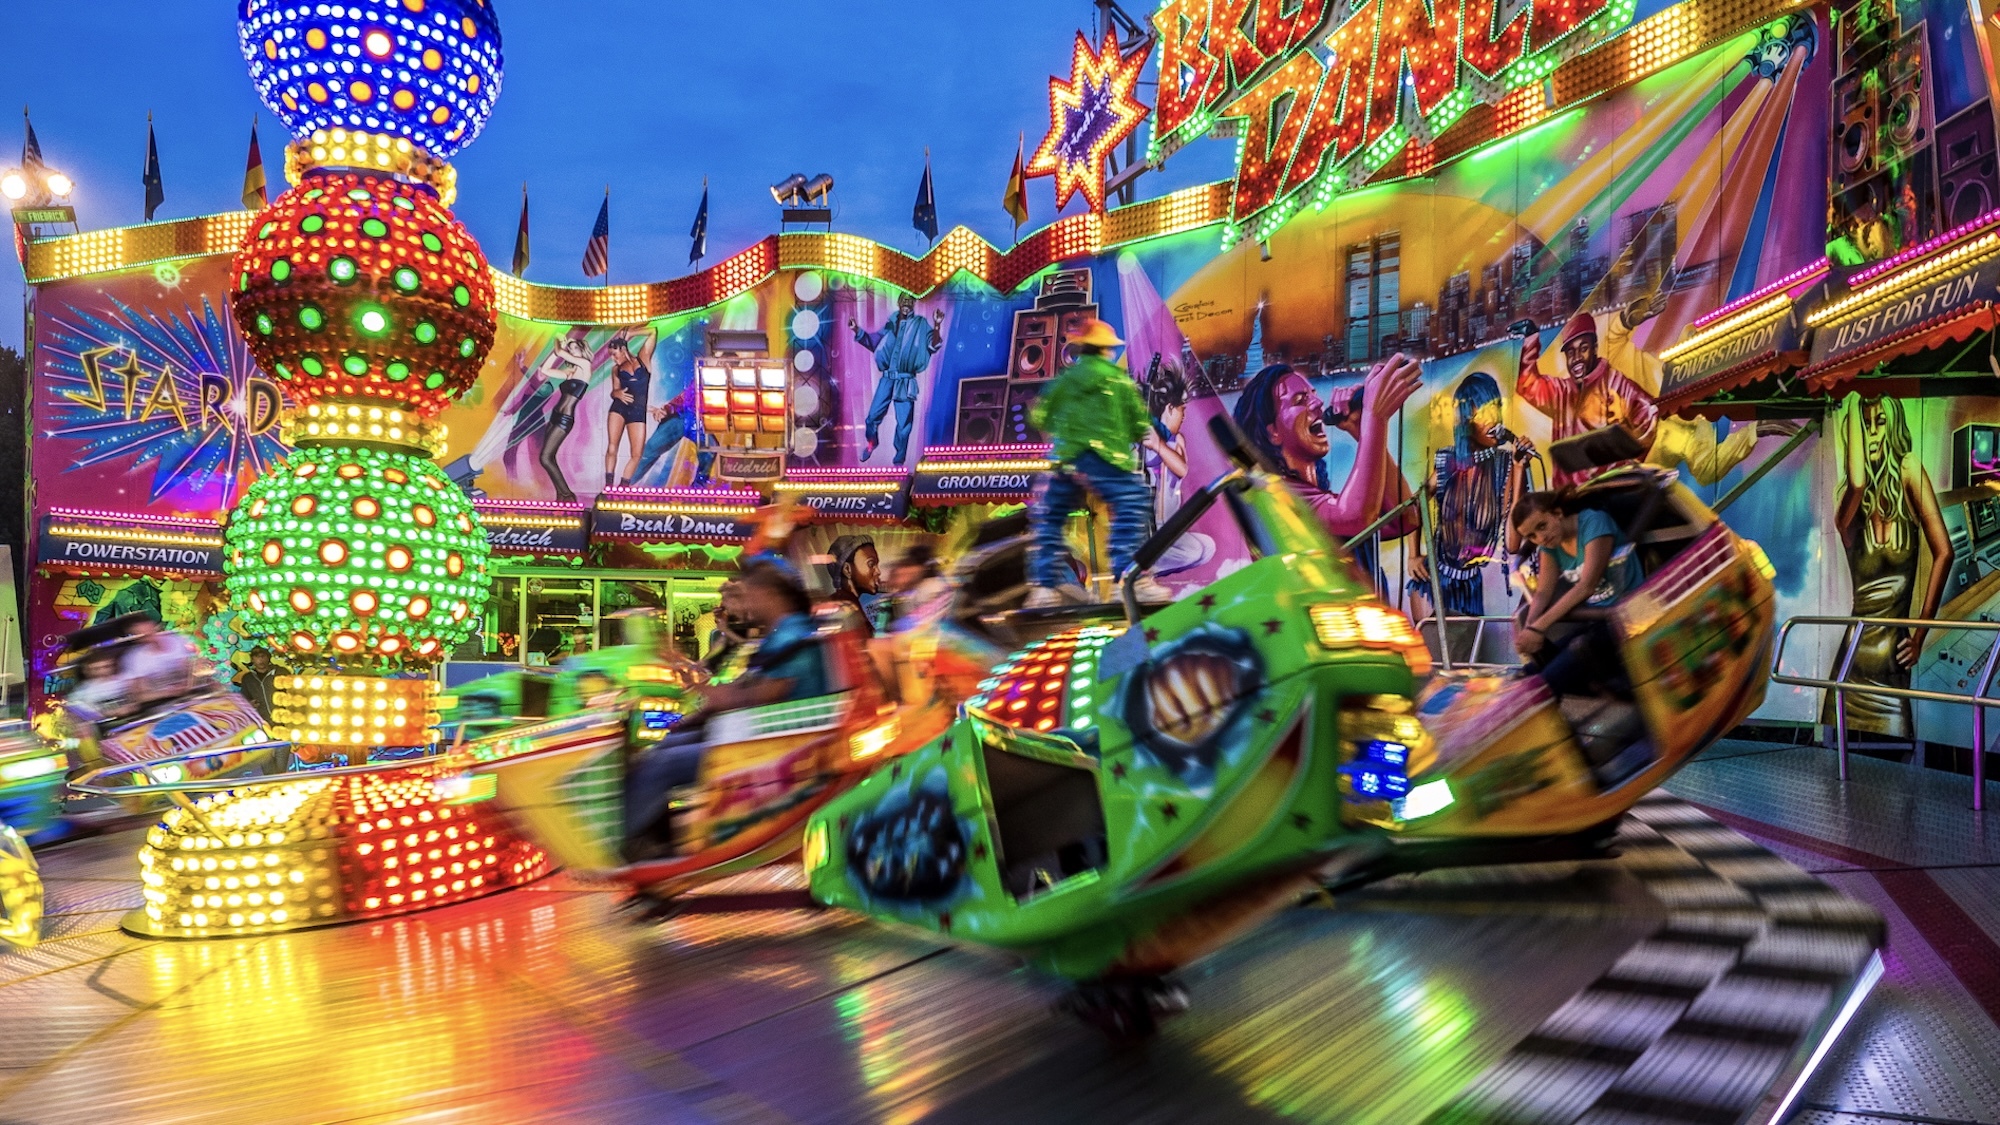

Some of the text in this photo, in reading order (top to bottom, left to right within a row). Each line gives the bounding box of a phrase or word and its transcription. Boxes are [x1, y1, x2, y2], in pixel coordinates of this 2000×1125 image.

[1214, 0, 1610, 224] DANC
[28, 211, 66, 221] FRIEDRICH
[1828, 271, 1979, 353] JUST FOR FUN
[1668, 322, 1778, 386] POWERSTATION
[721, 458, 778, 474] Friedrich
[937, 474, 1031, 489] GROOVEBOX
[805, 496, 867, 510] TOP-HITS
[620, 513, 735, 535] Break Dance
[65, 542, 210, 564] POWERSTATION
[683, 611, 695, 623] 66
